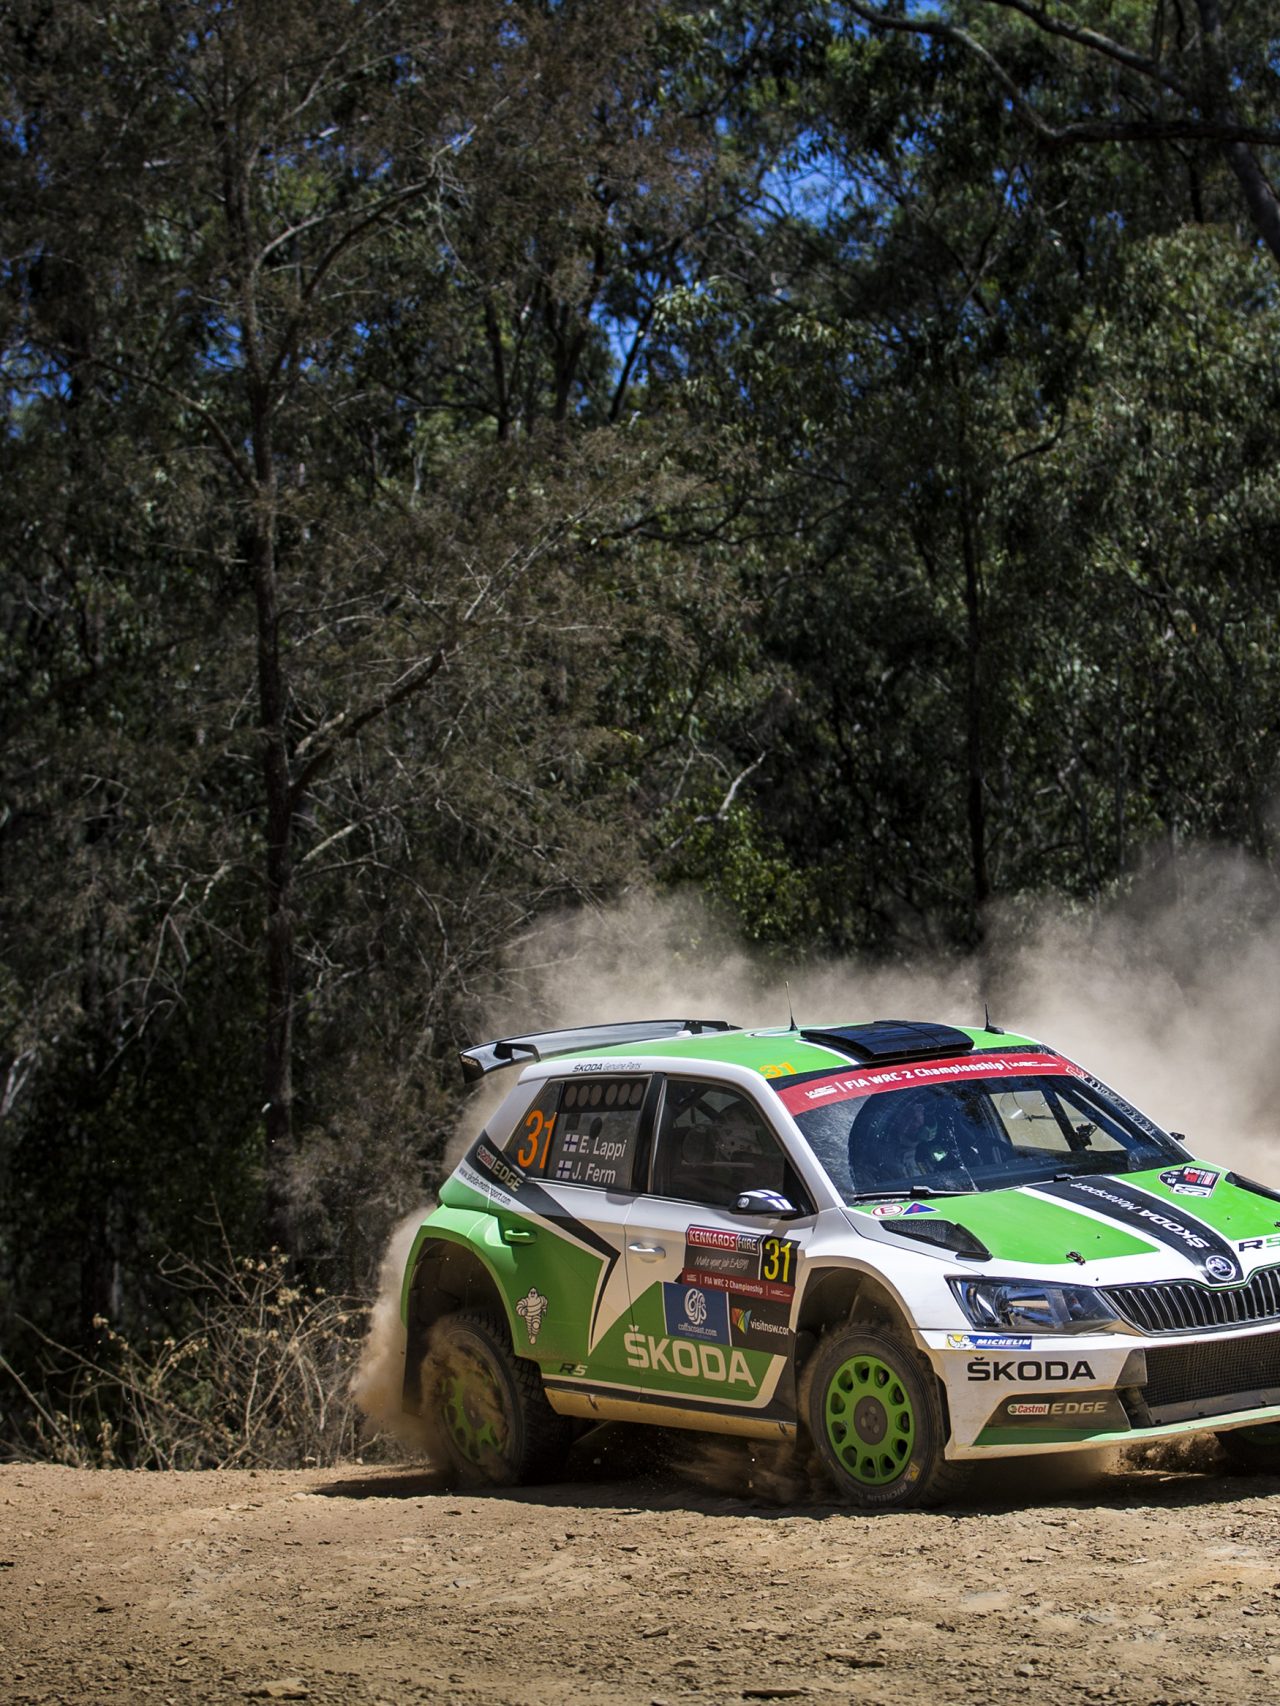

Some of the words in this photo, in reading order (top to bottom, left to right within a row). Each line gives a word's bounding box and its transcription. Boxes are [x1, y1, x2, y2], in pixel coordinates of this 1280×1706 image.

[761, 1061, 796, 1079] 31
[845, 1079, 870, 1091] FIA
[869, 1072, 902, 1084] WRC
[905, 1070, 915, 1079] 2
[917, 1061, 1004, 1078] Championship
[517, 1110, 557, 1169] 31
[579, 1135, 589, 1153] E.
[593, 1136, 627, 1160] Lappi
[491, 1160, 524, 1192] EDGE
[571, 1165, 582, 1180] J.
[586, 1163, 617, 1184] Ferm
[1070, 1182, 1140, 1210] Motorsport
[688, 1229, 736, 1248] KENNARDS
[738, 1236, 758, 1251] HIRE
[1140, 1209, 1210, 1248] ŠKODA
[763, 1238, 793, 1283] 31
[704, 1276, 713, 1285] FIA
[713, 1278, 724, 1287] WRC
[729, 1281, 763, 1295] Championship
[976, 1338, 1032, 1346] MICHELIN
[624, 1325, 757, 1388] ŠKODA
[560, 1362, 588, 1376] R5
[967, 1357, 1097, 1381] ŠKODA
[1017, 1404, 1048, 1414] Castrol
[1050, 1401, 1107, 1415] EDGE
